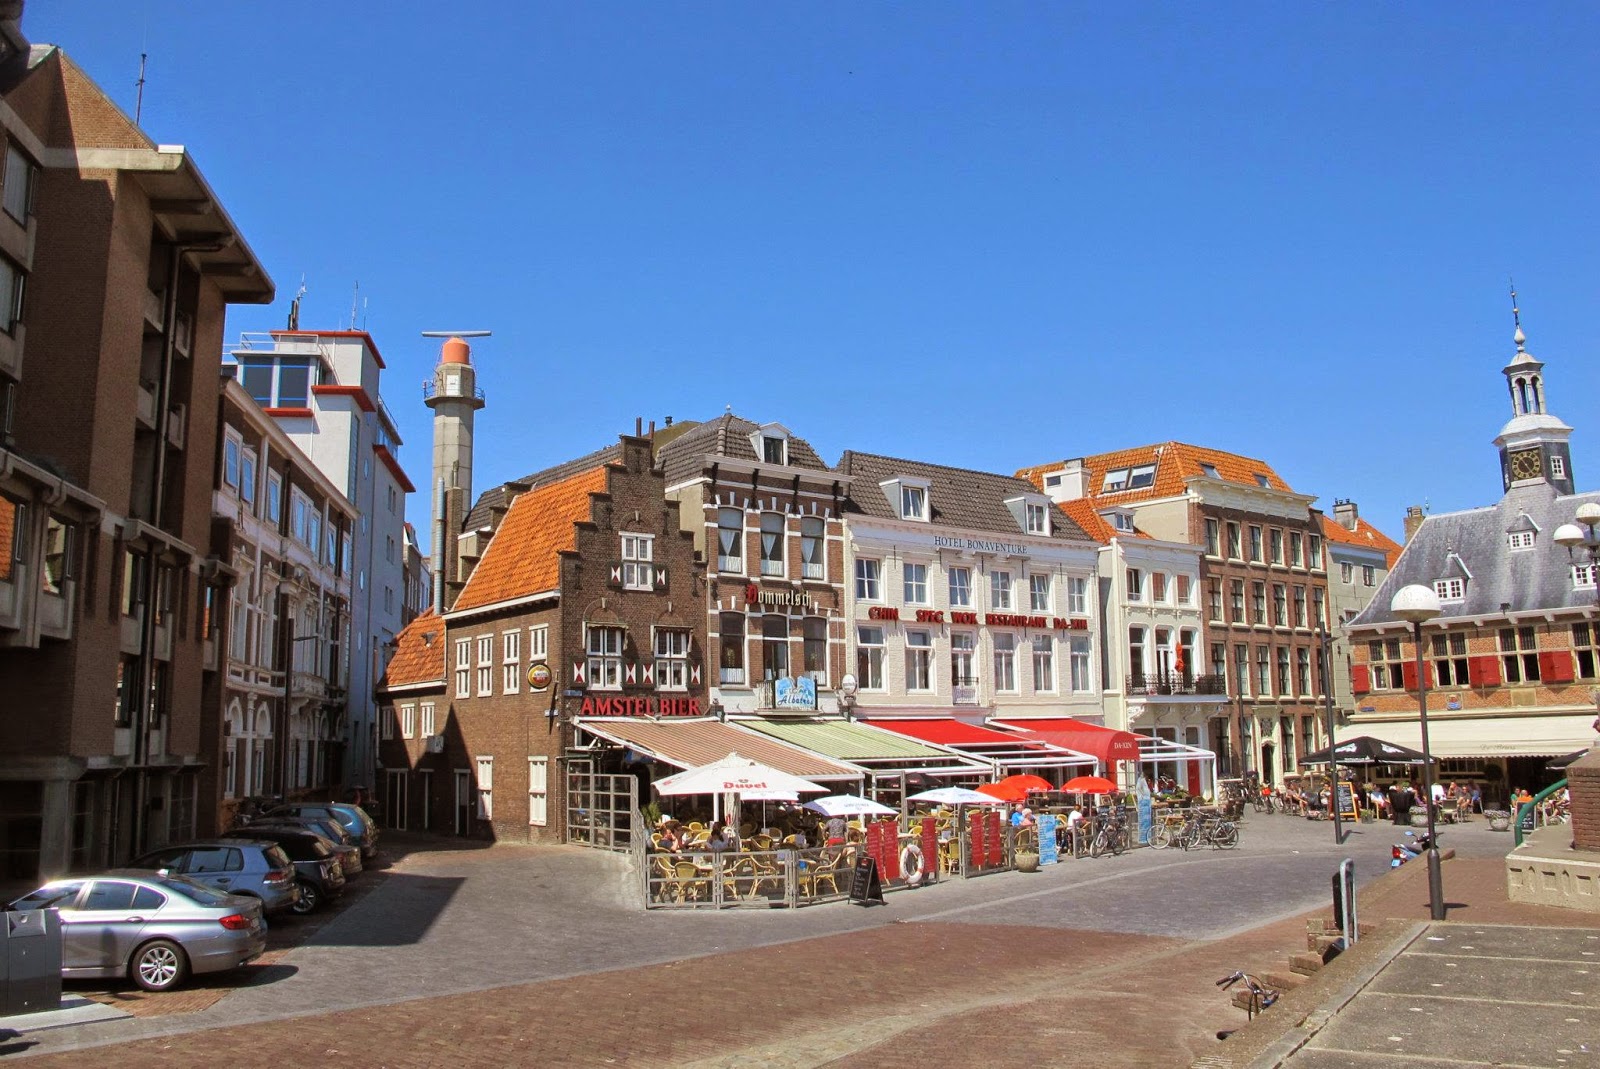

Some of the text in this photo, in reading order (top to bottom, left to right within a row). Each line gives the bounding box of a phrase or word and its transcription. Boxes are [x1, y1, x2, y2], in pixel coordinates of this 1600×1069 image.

[934, 535, 1028, 554] HOTEL BONAVENTURE
[745, 583, 812, 609] Dommelsch
[868, 606, 899, 620] CHIN
[916, 609, 945, 623] SPEC
[950, 611, 978, 625] WOK
[985, 613, 1047, 628] RESTAURANT
[581, 697, 702, 716] AMSTEL BIER
[777, 694, 814, 706] Albatros
